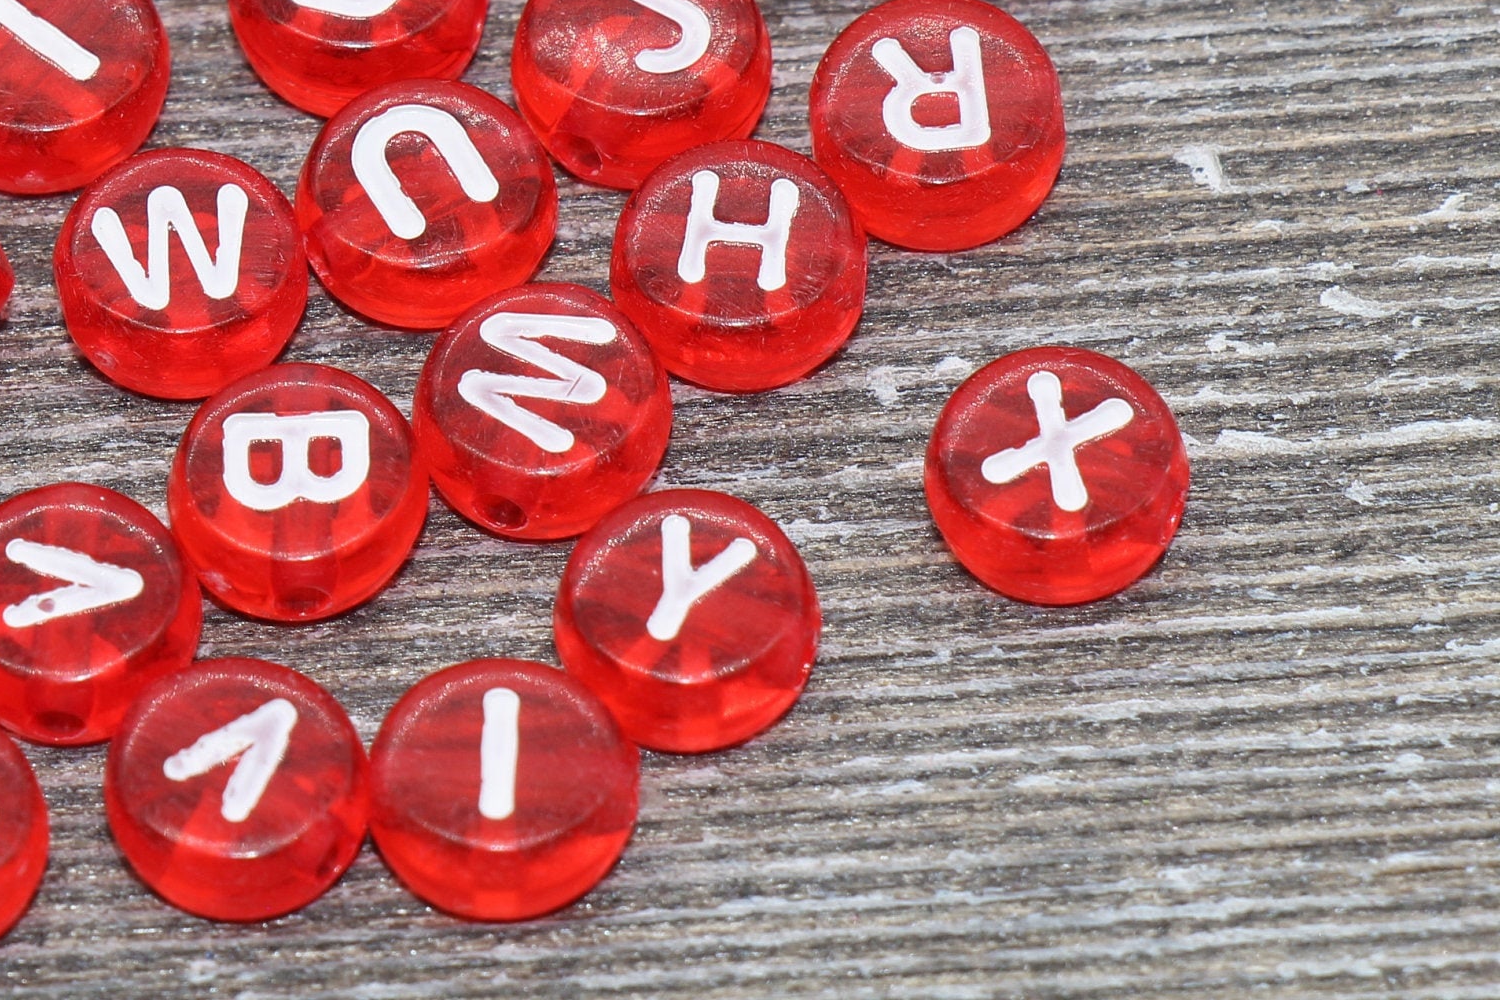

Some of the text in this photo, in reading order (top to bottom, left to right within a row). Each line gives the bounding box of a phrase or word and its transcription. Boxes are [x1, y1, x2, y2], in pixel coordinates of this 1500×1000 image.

[871, 25, 992, 153] R
[351, 103, 500, 240] U
[677, 169, 800, 292] H
[91, 183, 249, 311] W
[222, 409, 371, 512] B
[981, 370, 1134, 512] X
[2, 537, 144, 629] V
[646, 513, 757, 641] Y
[163, 698, 298, 823] V
[478, 687, 521, 820] I
